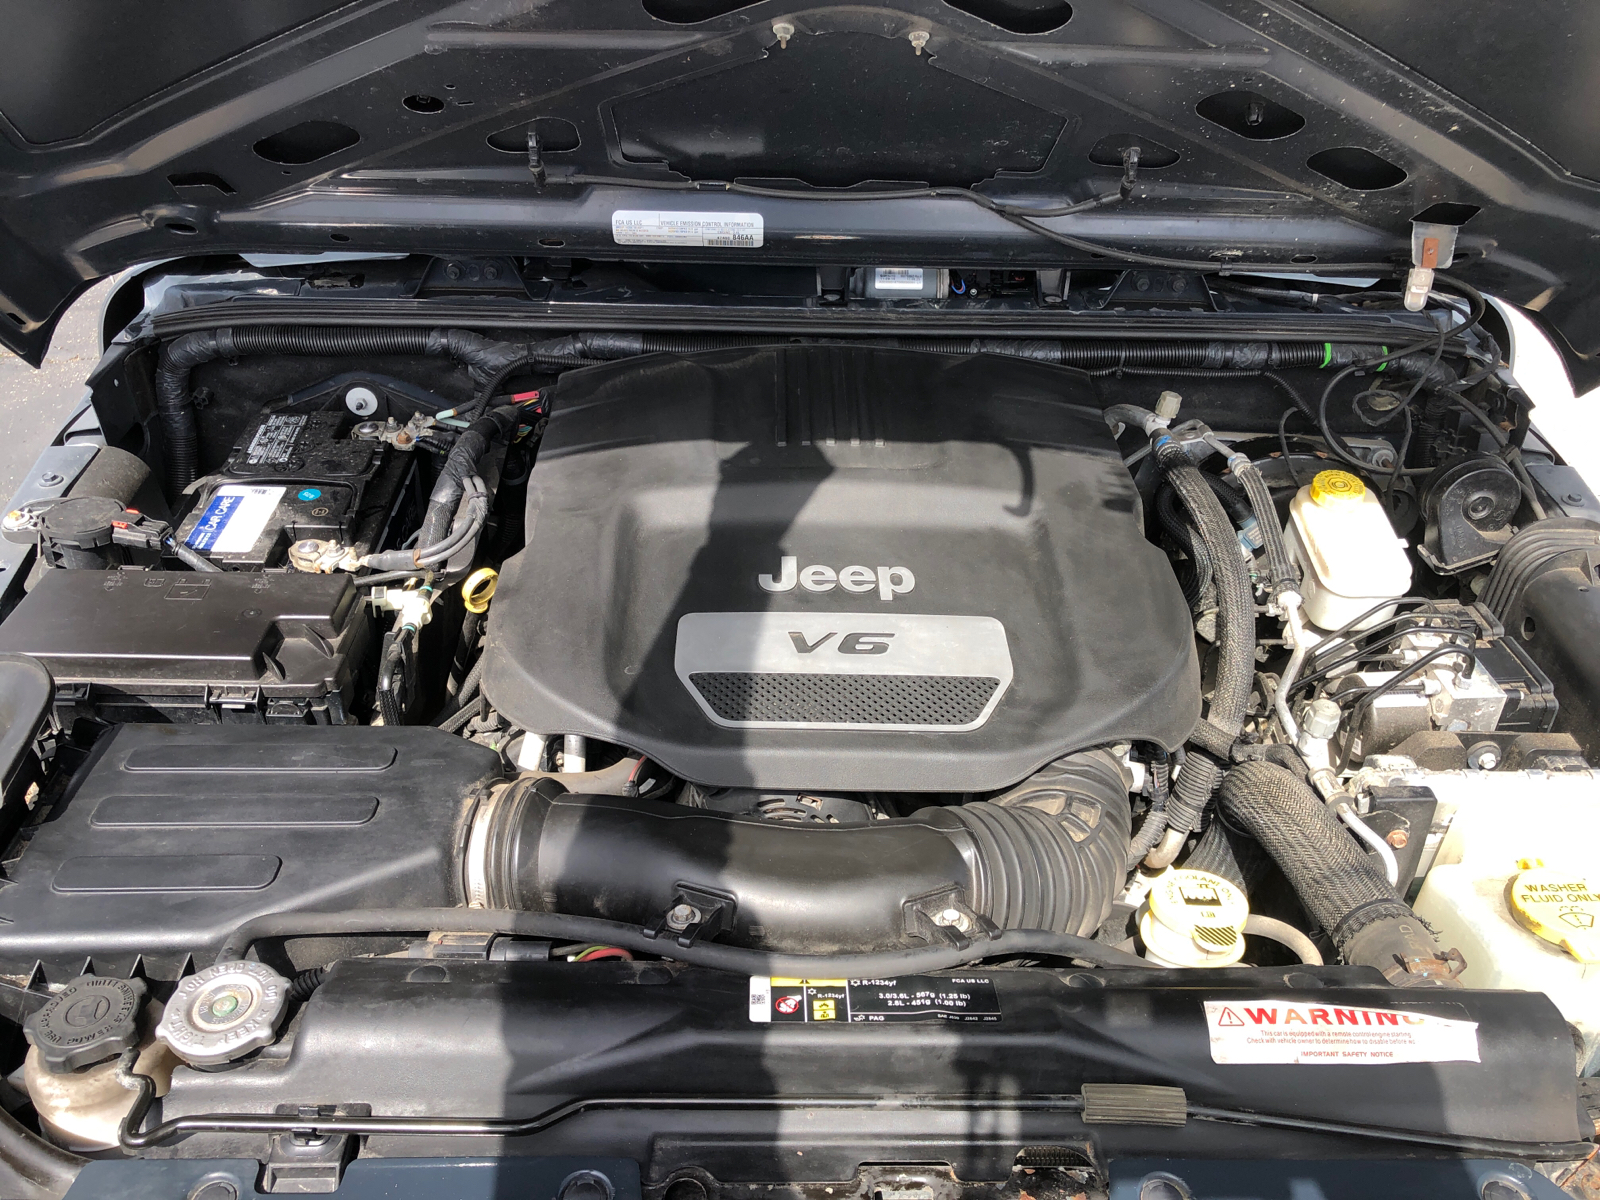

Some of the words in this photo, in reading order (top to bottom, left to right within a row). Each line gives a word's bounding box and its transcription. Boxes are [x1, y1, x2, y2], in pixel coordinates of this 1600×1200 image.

[204, 514, 221, 531] CAR
[215, 496, 236, 515] CARE
[758, 556, 916, 600] Jeep
[787, 631, 896, 656] V6
[1523, 883, 1588, 893] WASHER
[1520, 893, 1564, 903] FLUID
[862, 979, 897, 988] R-1234yf
[878, 992, 910, 1000] 3.0/3.6L
[939, 992, 959, 1001] (1.25
[959, 992, 971, 1001] lb)
[934, 999, 954, 1007] (1.00
[955, 1000, 967, 1008] lb)
[1261, 1029, 1273, 1037] This
[1289, 1030, 1316, 1038] equipped
[1315, 1030, 1326, 1038] with
[1371, 1031, 1390, 1039] engine
[1391, 1031, 1412, 1039] starting
[1278, 1037, 1297, 1045] vehicle
[1321, 1037, 1350, 1045] determine
[1369, 1037, 1388, 1045] disable
[1389, 1037, 1405, 1045] before
